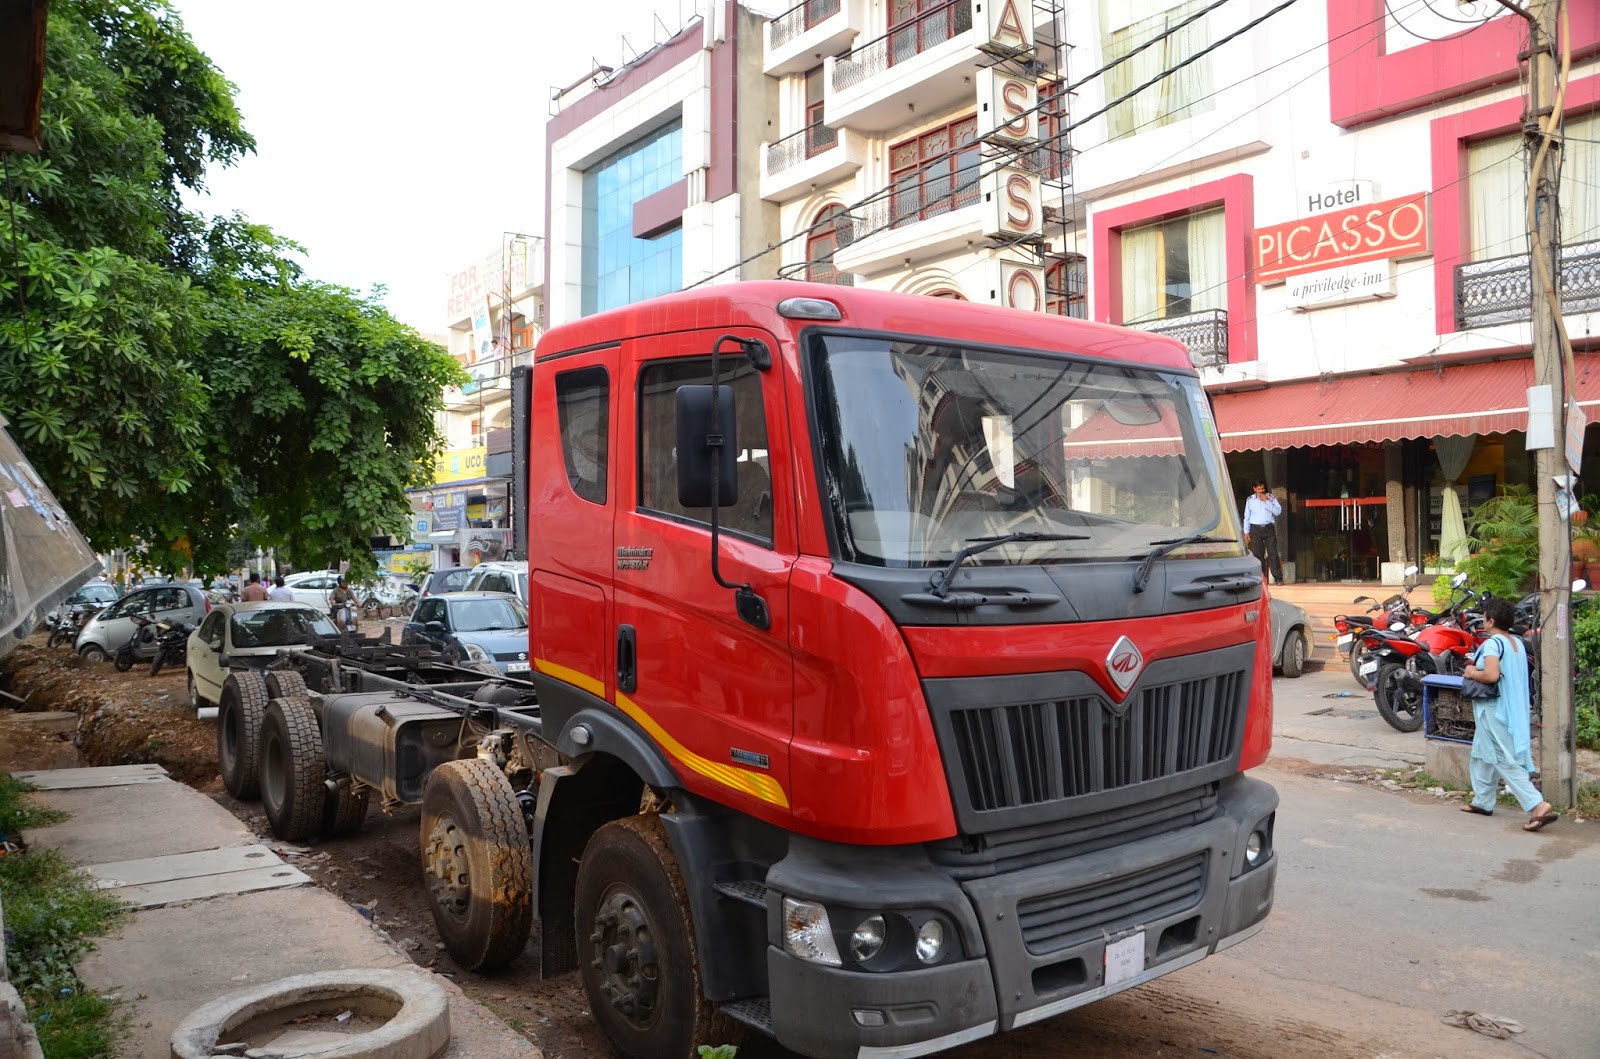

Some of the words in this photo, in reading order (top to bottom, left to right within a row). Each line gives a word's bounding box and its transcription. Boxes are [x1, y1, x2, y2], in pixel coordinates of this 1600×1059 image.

[1308, 184, 1361, 212] Hotel
[1258, 202, 1424, 267] PICASSO
[451, 265, 477, 295] FOR
[447, 284, 482, 317] RENT
[1292, 285, 1299, 297] a
[465, 455, 482, 469] UCO
[617, 546, 653, 557] Mahindra
[617, 560, 649, 570] NAVISTAR
